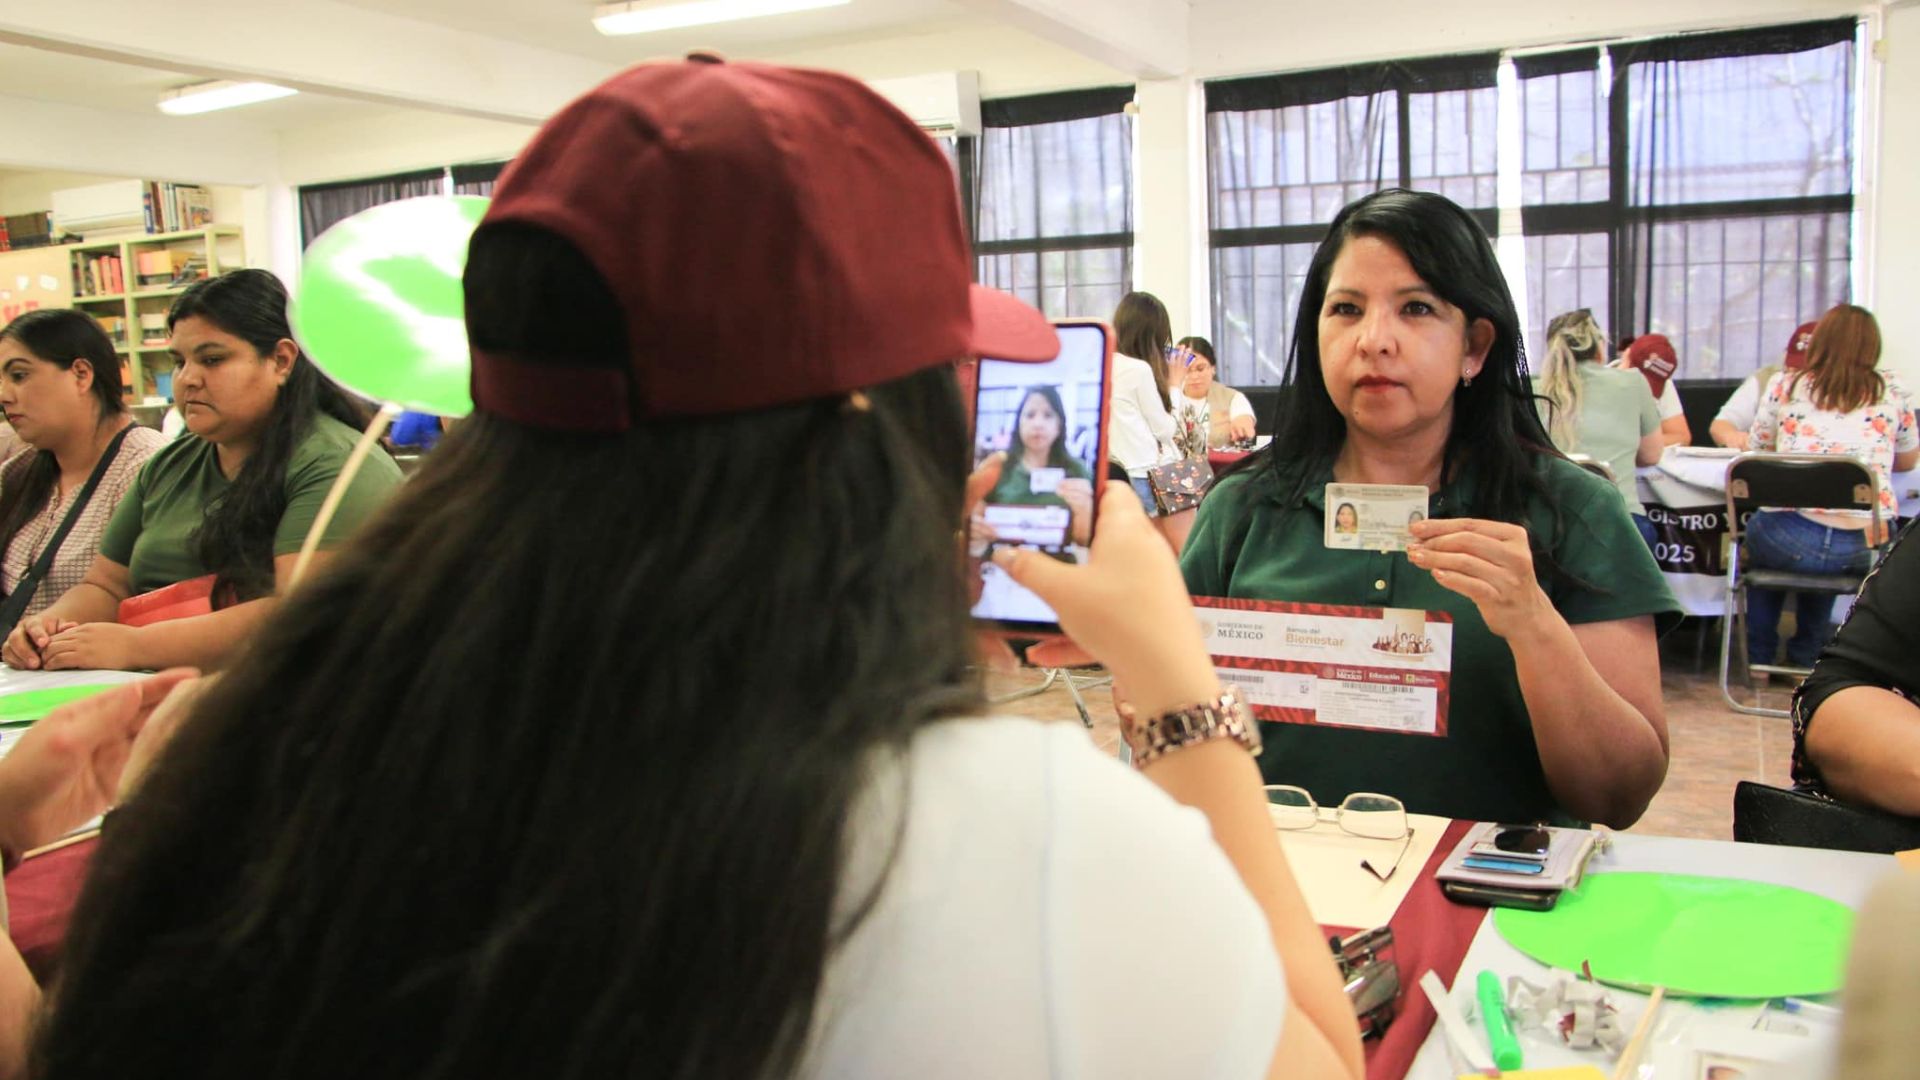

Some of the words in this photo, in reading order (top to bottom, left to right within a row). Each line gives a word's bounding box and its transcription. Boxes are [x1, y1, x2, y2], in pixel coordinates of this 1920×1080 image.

[1655, 542, 1695, 563] 025
[1217, 629, 1264, 640] MÉXICO
[1286, 633, 1344, 647] Bienestar
